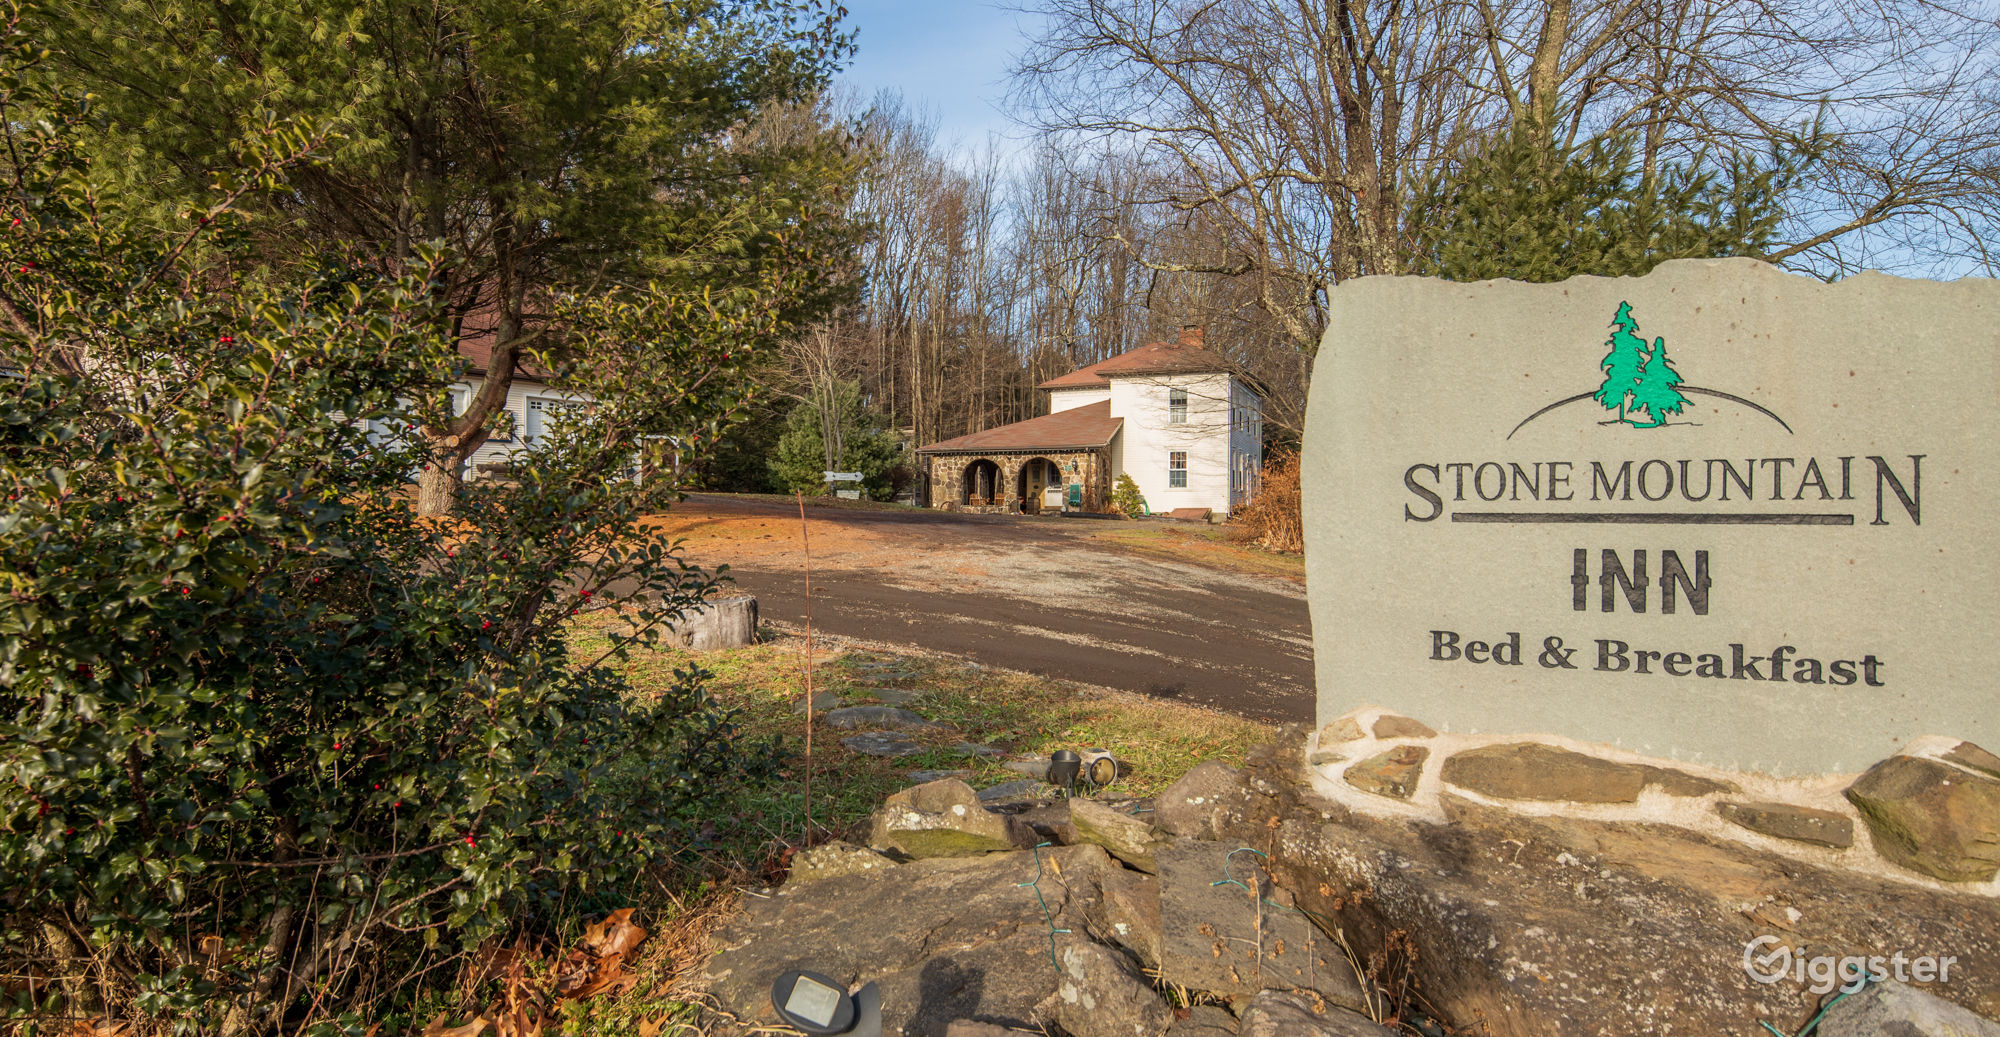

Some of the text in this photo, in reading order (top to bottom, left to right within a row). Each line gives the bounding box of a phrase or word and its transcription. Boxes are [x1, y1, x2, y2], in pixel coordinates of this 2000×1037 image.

[1404, 454, 1926, 526] STONE MOUNTAIN
[1571, 548, 1712, 615] INN
[1429, 630, 1885, 687] Bed & Breakfast
